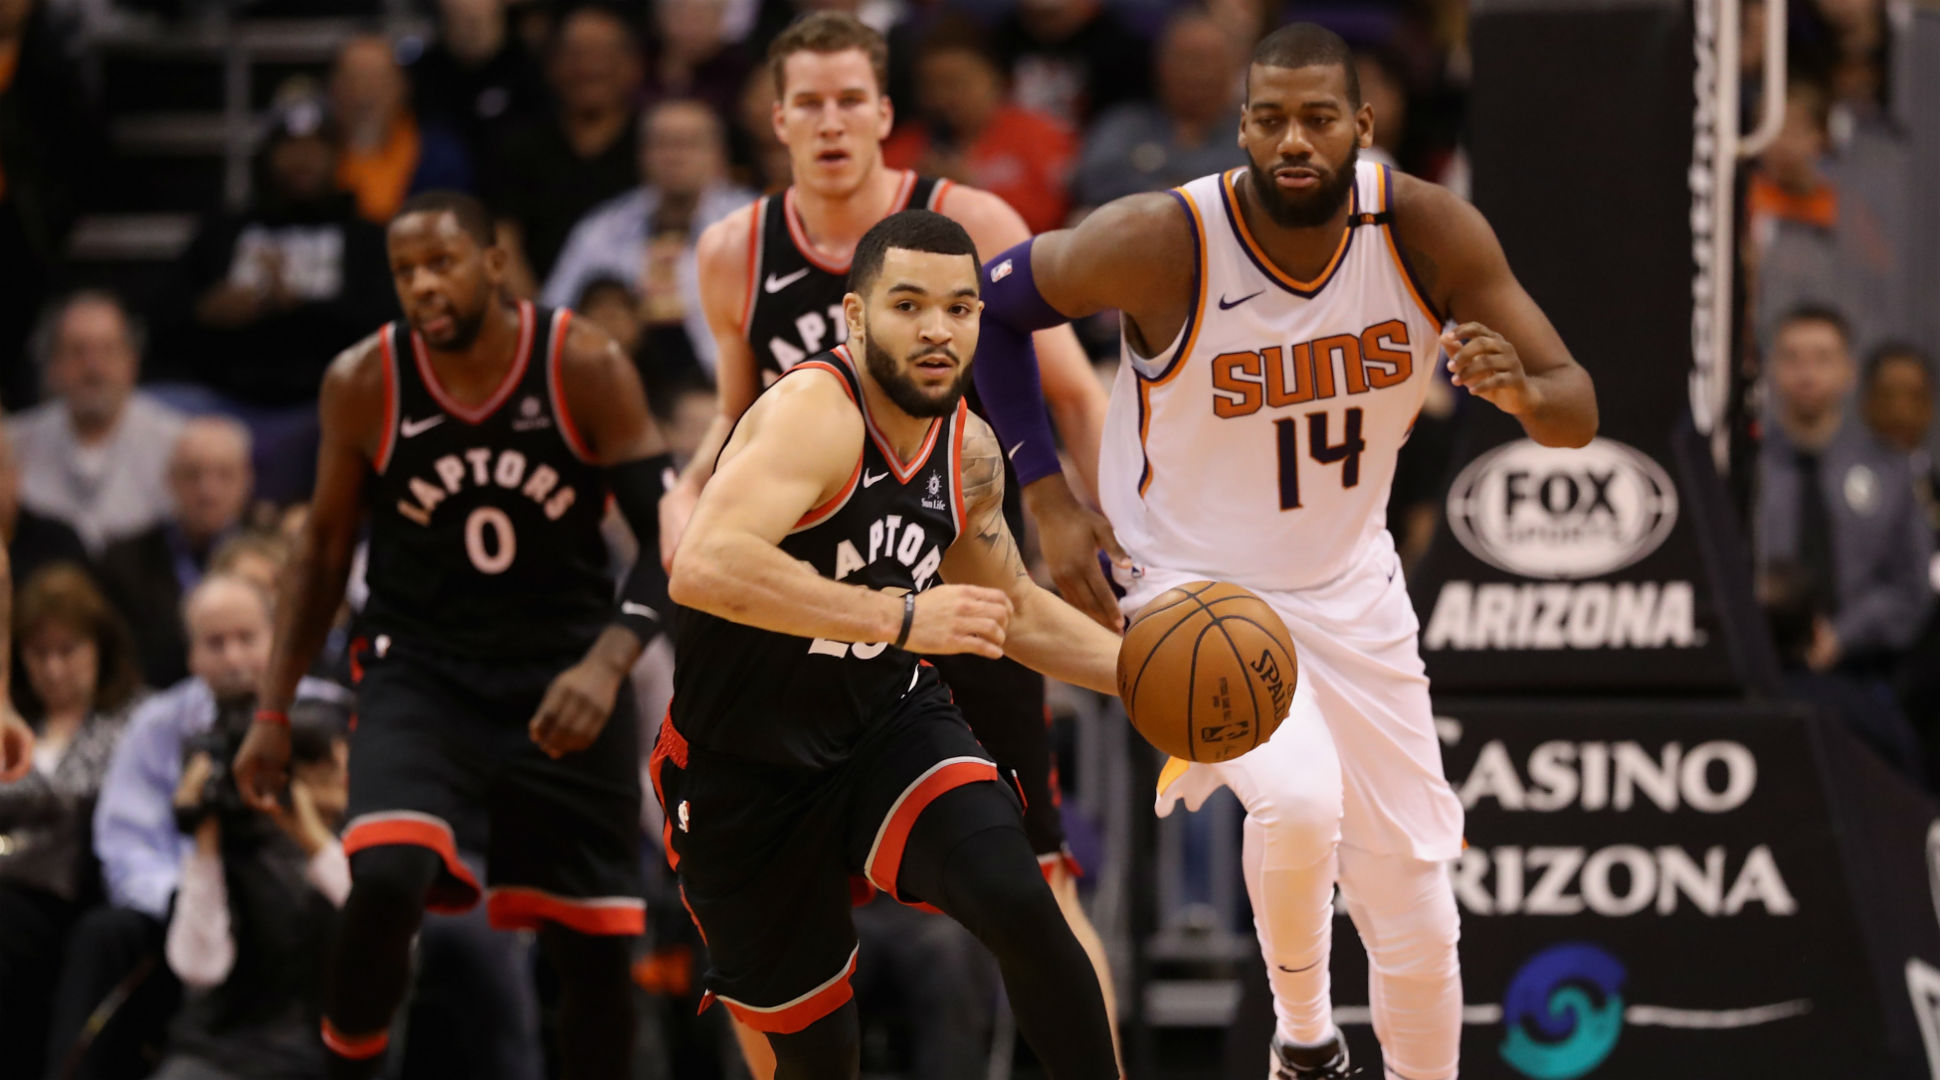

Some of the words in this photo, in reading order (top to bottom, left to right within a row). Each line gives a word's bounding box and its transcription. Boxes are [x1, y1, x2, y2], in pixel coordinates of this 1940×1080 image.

[1211, 318, 1413, 420] SUNS
[1272, 406, 1366, 512] 14
[1503, 470, 1617, 519] FOX
[464, 506, 516, 575] 0
[1422, 581, 1696, 649] ARIZONA
[1334, 844, 1798, 916] RIZONA
